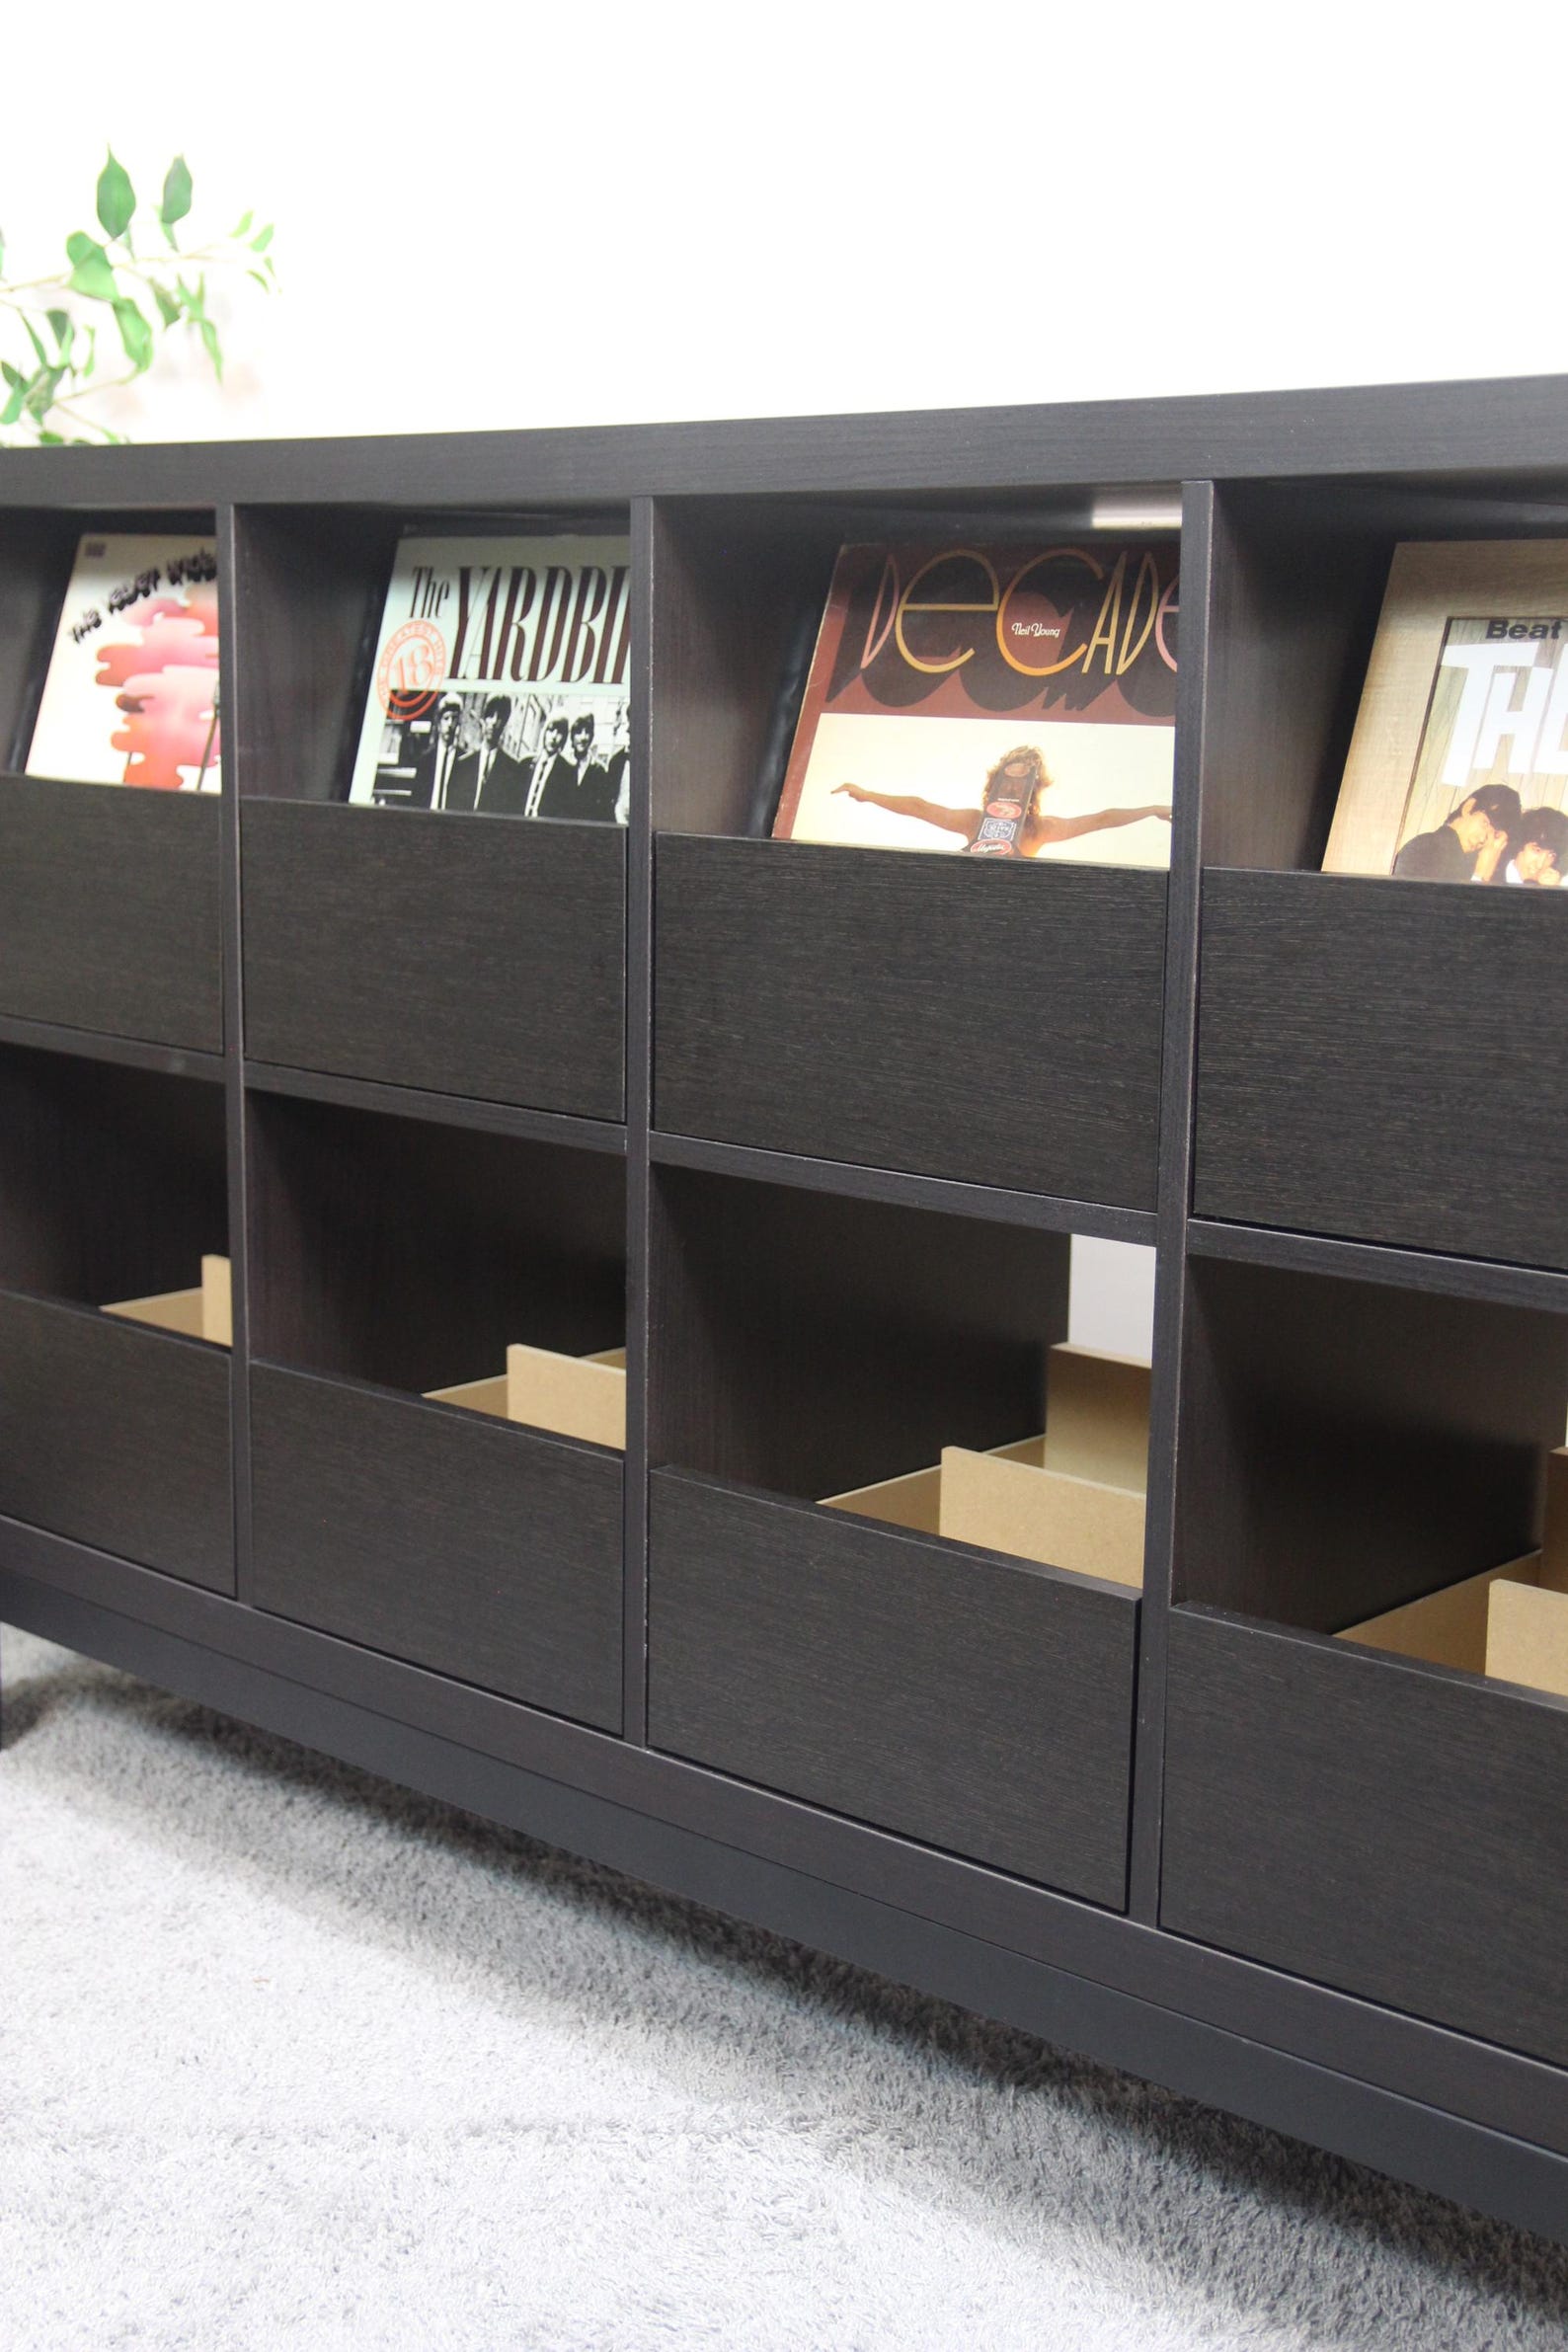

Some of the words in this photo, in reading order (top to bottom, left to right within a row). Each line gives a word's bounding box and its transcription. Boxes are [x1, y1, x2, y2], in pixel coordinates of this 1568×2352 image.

[409, 566, 450, 618] The
[1011, 622, 1030, 636] Neil
[1031, 623, 1060, 638] Young
[1486, 620, 1562, 639] Beat
